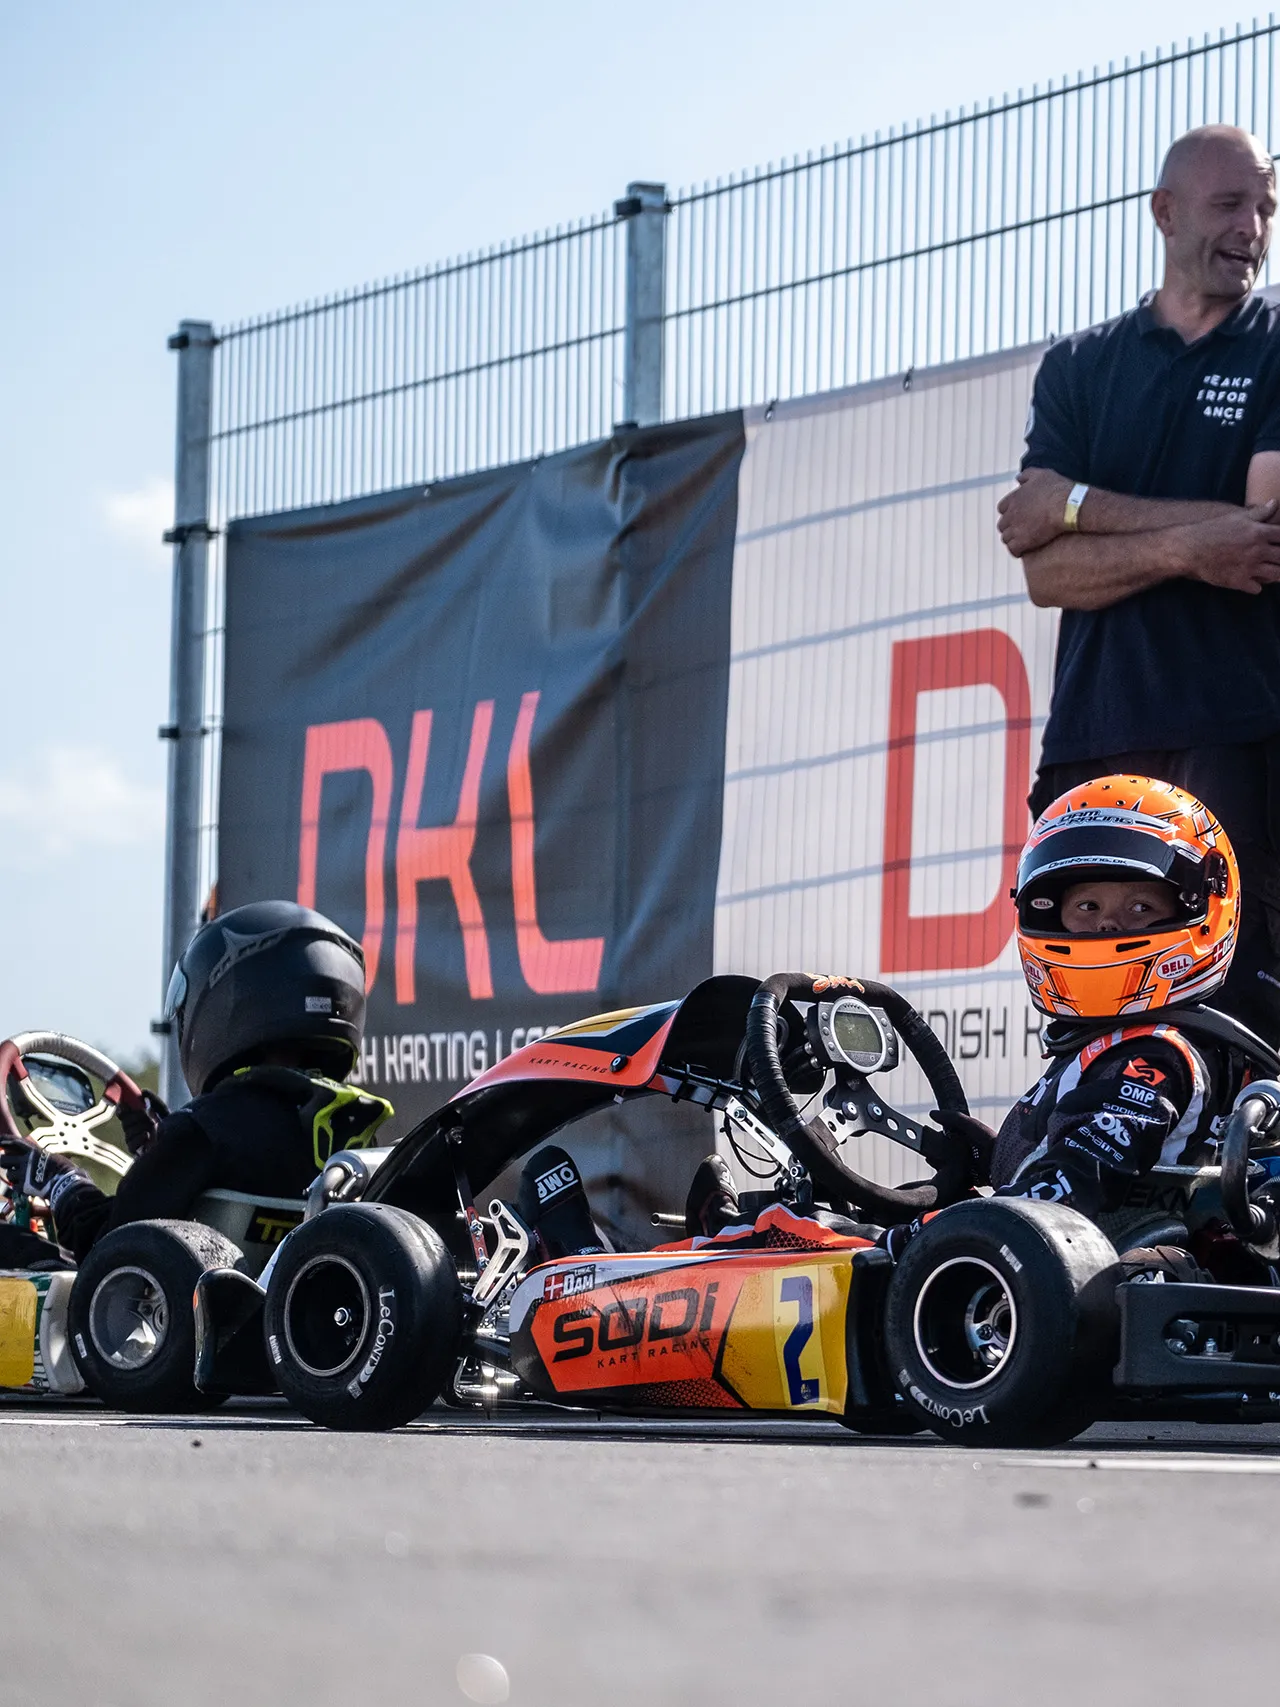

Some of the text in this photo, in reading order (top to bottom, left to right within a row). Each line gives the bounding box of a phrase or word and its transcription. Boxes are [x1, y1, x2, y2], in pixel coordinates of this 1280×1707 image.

[297, 690, 604, 1005] DKL
[1160, 957, 1191, 975] BELL
[384, 1029, 488, 1085] KARTING
[528, 1056, 609, 1075] KART RACING
[1120, 1084, 1156, 1104] OMP
[536, 1166, 575, 1199] OMP
[562, 1273, 594, 1297] DAM
[596, 1338, 711, 1370] KART RACING
[780, 1275, 820, 1406] 2
